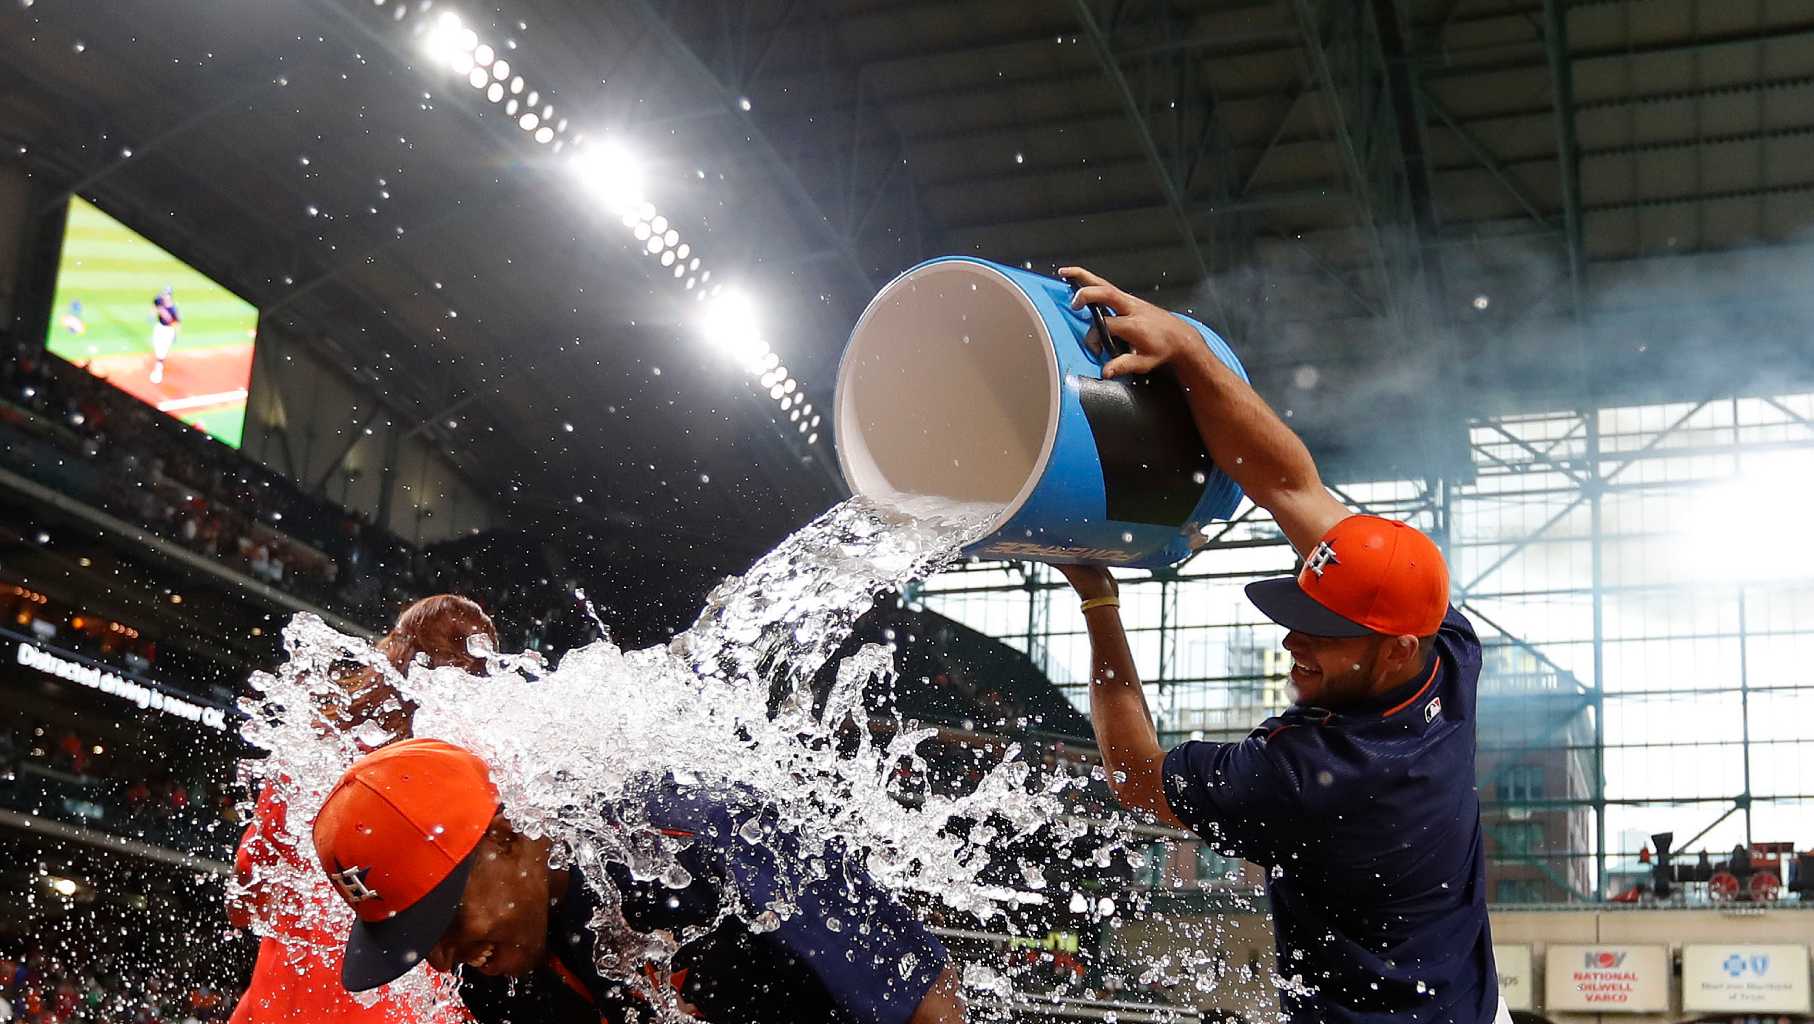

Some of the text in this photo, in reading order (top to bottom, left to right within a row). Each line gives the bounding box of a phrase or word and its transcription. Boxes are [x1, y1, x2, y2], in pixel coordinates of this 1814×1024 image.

[17, 642, 101, 688] Distracted
[100, 672, 150, 709] driving
[150, 688, 163, 709] is
[163, 695, 201, 721] never
[1584, 951, 1627, 969] NOV
[1573, 971, 1639, 982] NATIONAL
[1584, 993, 1628, 1004] VARCO
